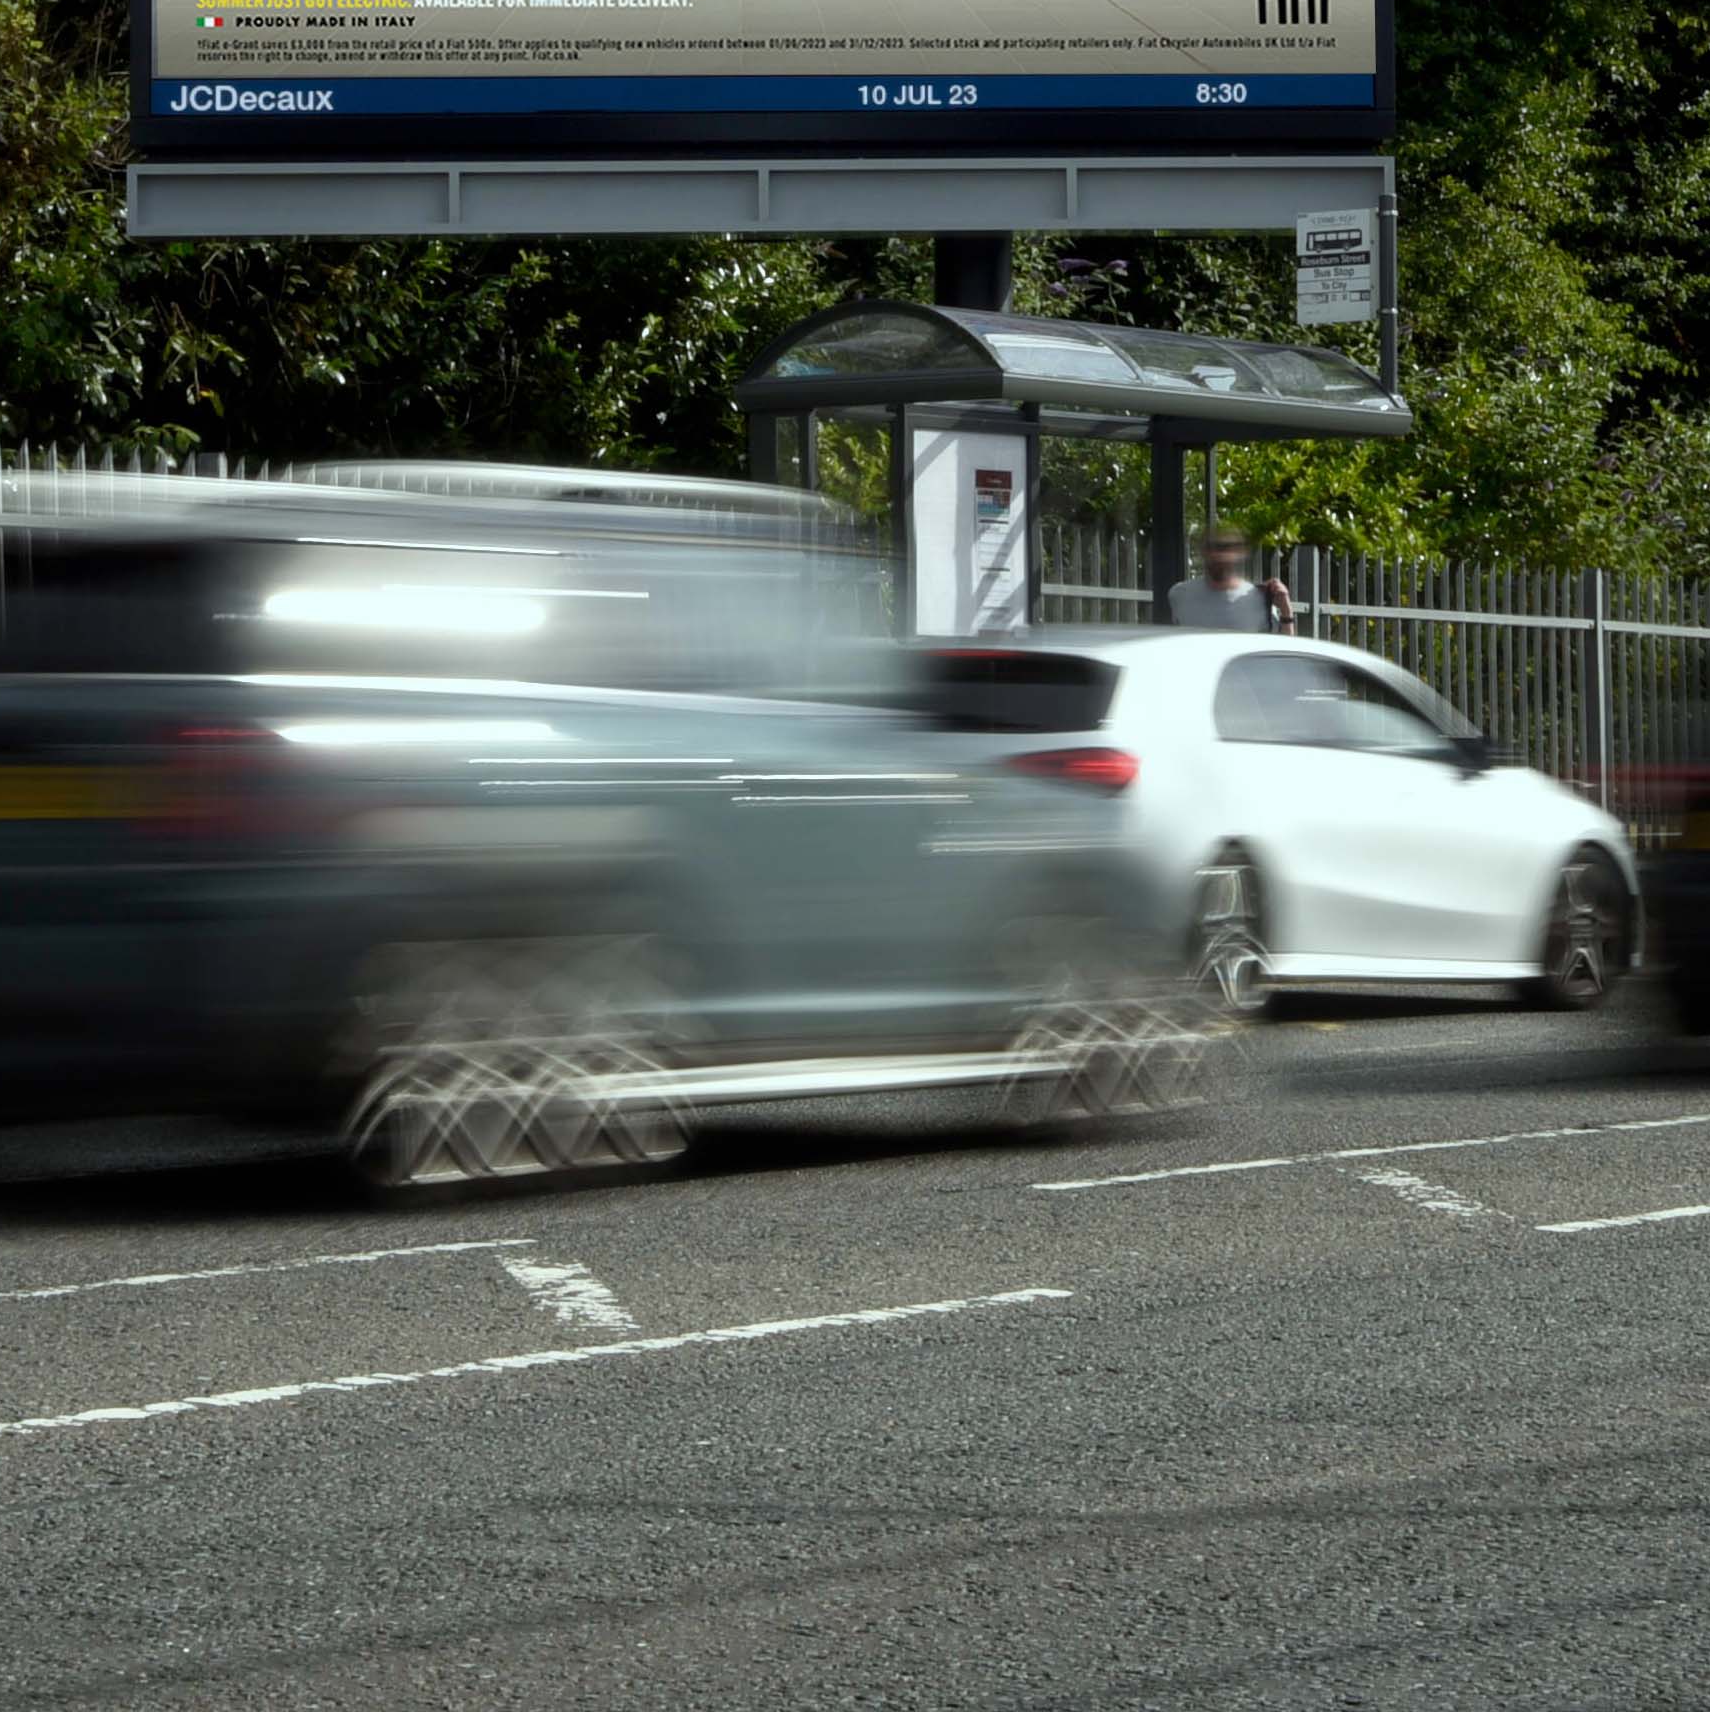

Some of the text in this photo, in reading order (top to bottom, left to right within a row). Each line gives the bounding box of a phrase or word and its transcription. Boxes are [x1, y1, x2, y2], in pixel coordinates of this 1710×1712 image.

[236, 16, 416, 27] PROUDLY MADE IN ITALY
[170, 85, 334, 112] JCDecaux
[858, 85, 978, 105] 10 JUL 23
[1196, 83, 1247, 103] 8:30
[1341, 254, 1366, 264] Street
[1334, 267, 1354, 277] Stop
